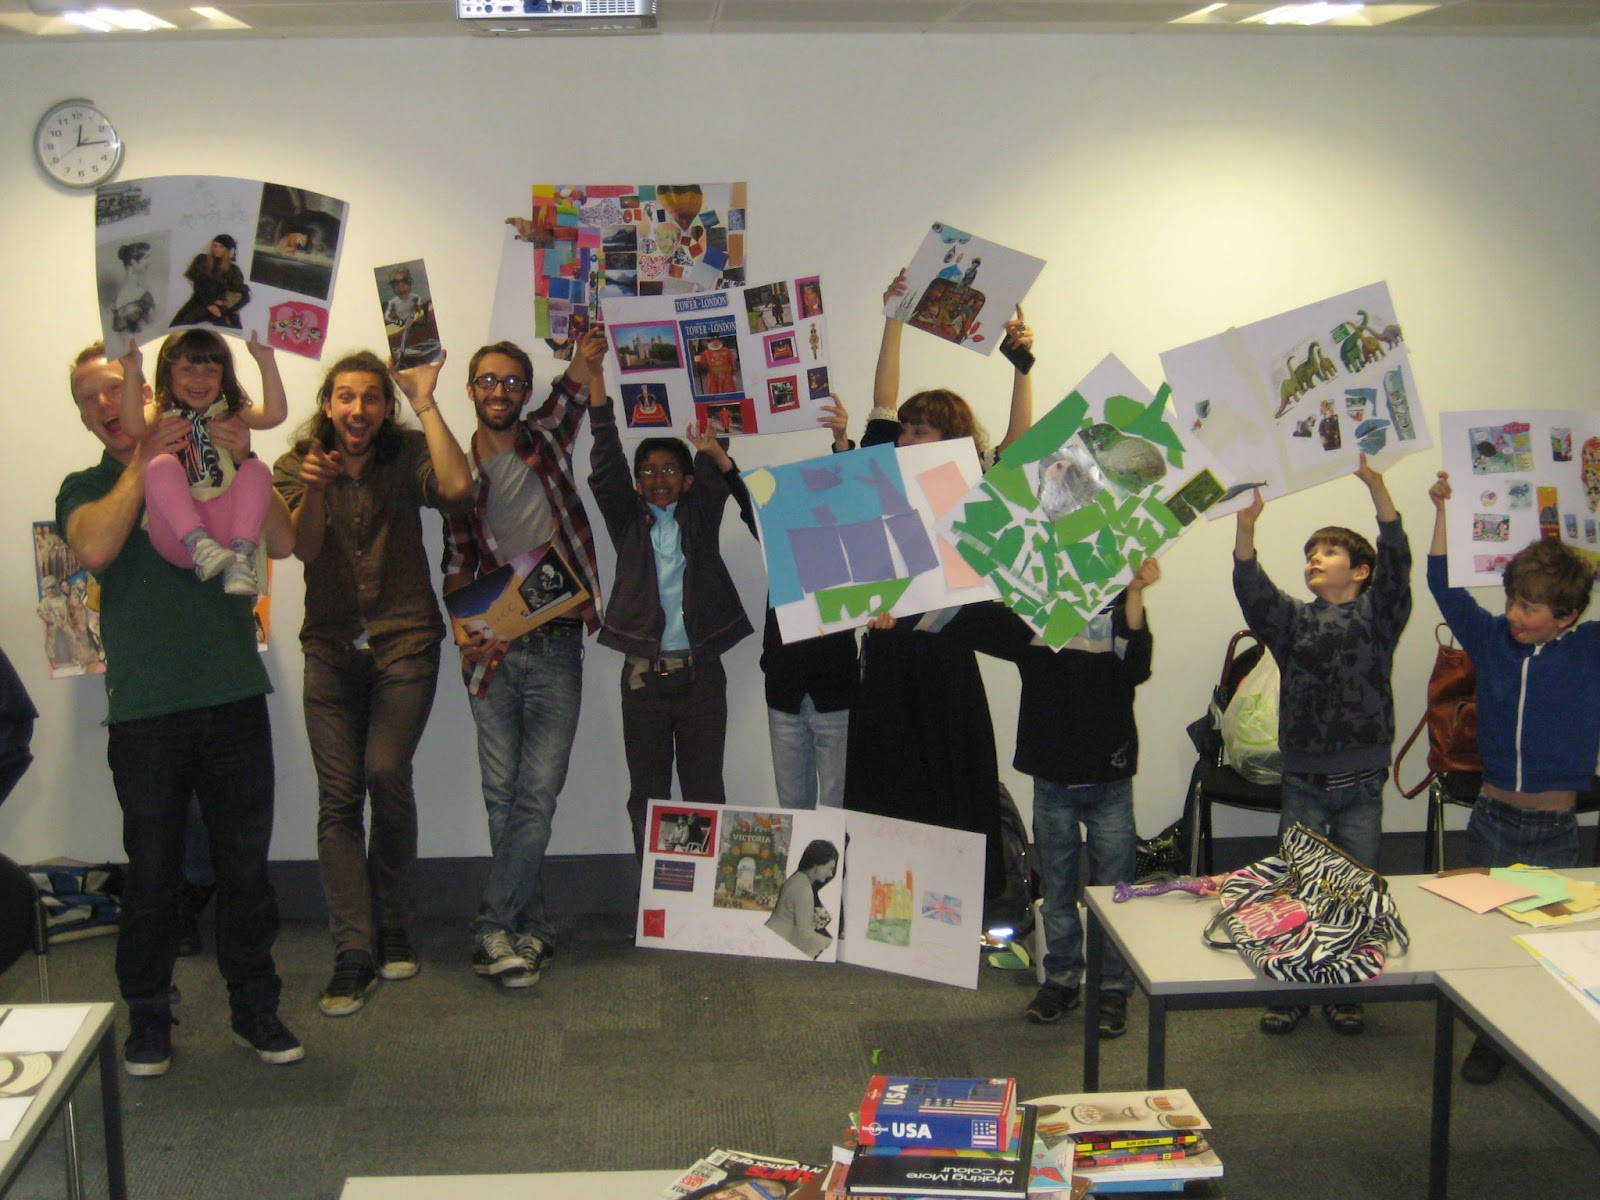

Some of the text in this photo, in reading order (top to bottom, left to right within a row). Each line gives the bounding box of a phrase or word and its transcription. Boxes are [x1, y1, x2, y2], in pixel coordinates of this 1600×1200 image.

[676, 299, 698, 311] TOWER
[701, 296, 727, 308] LONDON
[685, 325, 708, 336] TOWER
[710, 320, 737, 333] LONDON
[732, 833, 771, 843] VICTORIA
[882, 1084, 909, 1106] USA
[892, 1122, 933, 1139] USA
[906, 1172, 1014, 1185] Making More
[942, 1166, 997, 1176] Colour
